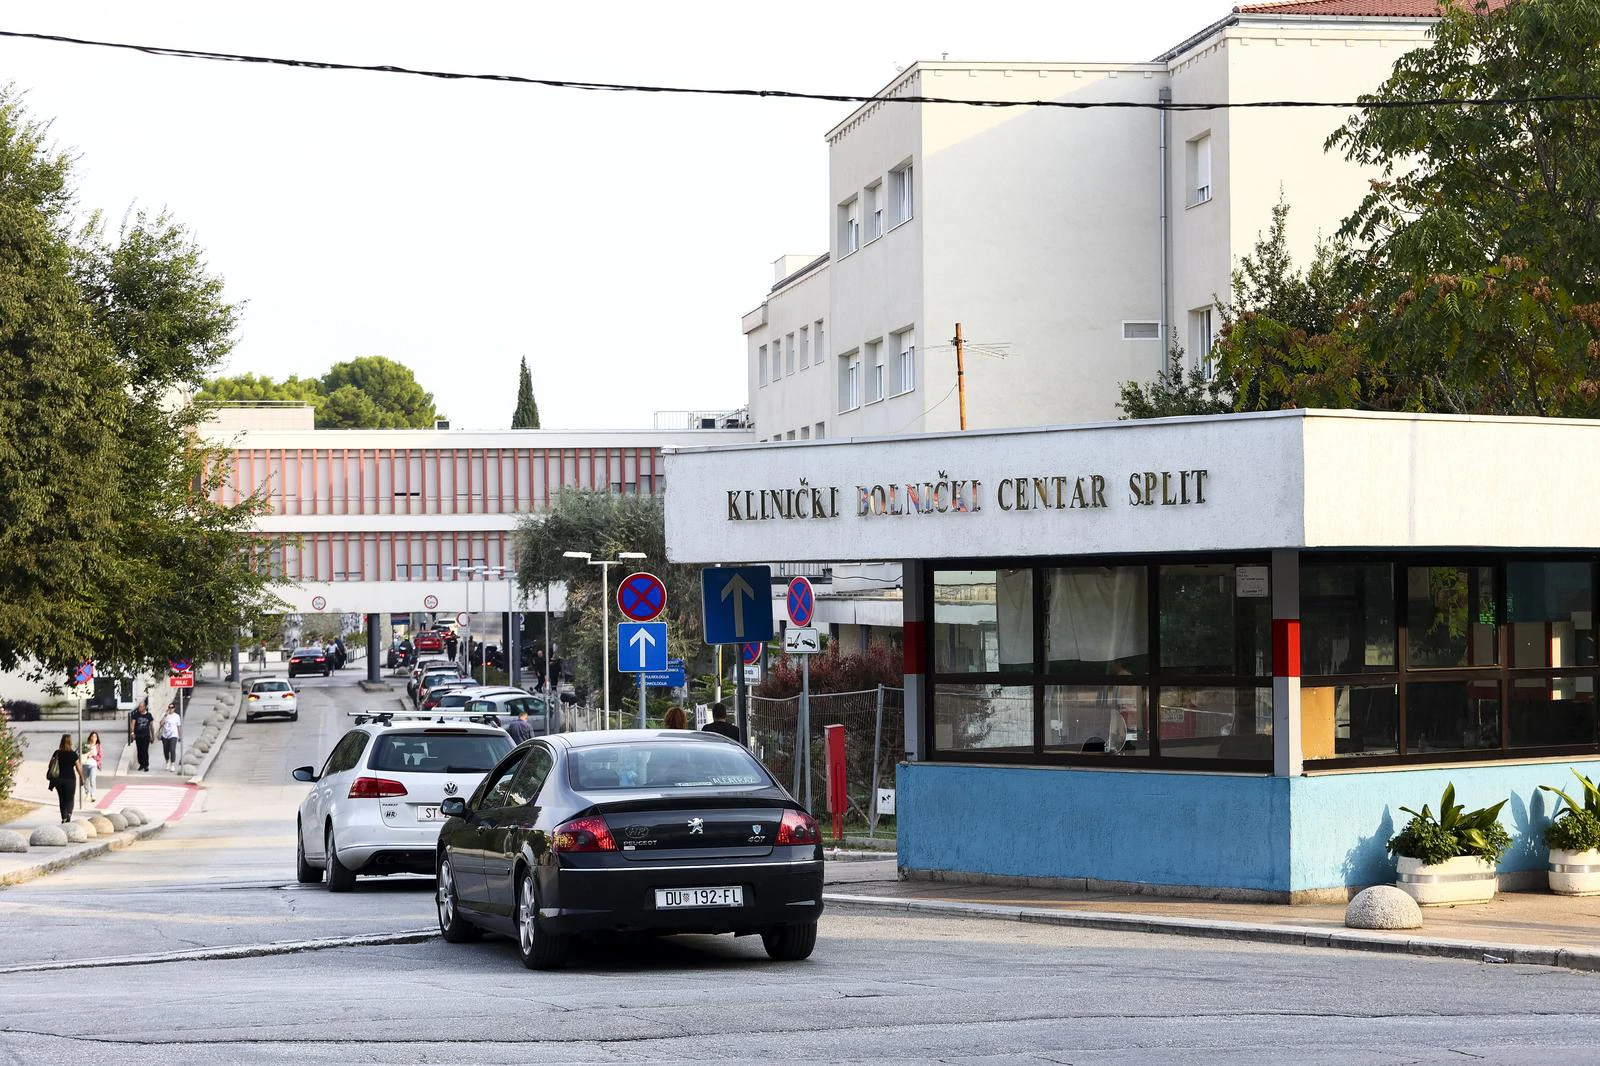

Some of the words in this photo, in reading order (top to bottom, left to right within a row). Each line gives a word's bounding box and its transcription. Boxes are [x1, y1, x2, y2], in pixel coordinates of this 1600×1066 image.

[727, 477, 839, 520] KLINIČKI
[855, 470, 981, 516] BOLNIČKI
[997, 474, 1108, 511] CENTAR
[1128, 469, 1208, 506] SPLIT
[425, 808, 437, 818] ST
[666, 891, 682, 905] DU
[694, 889, 739, 904] 192-FL
